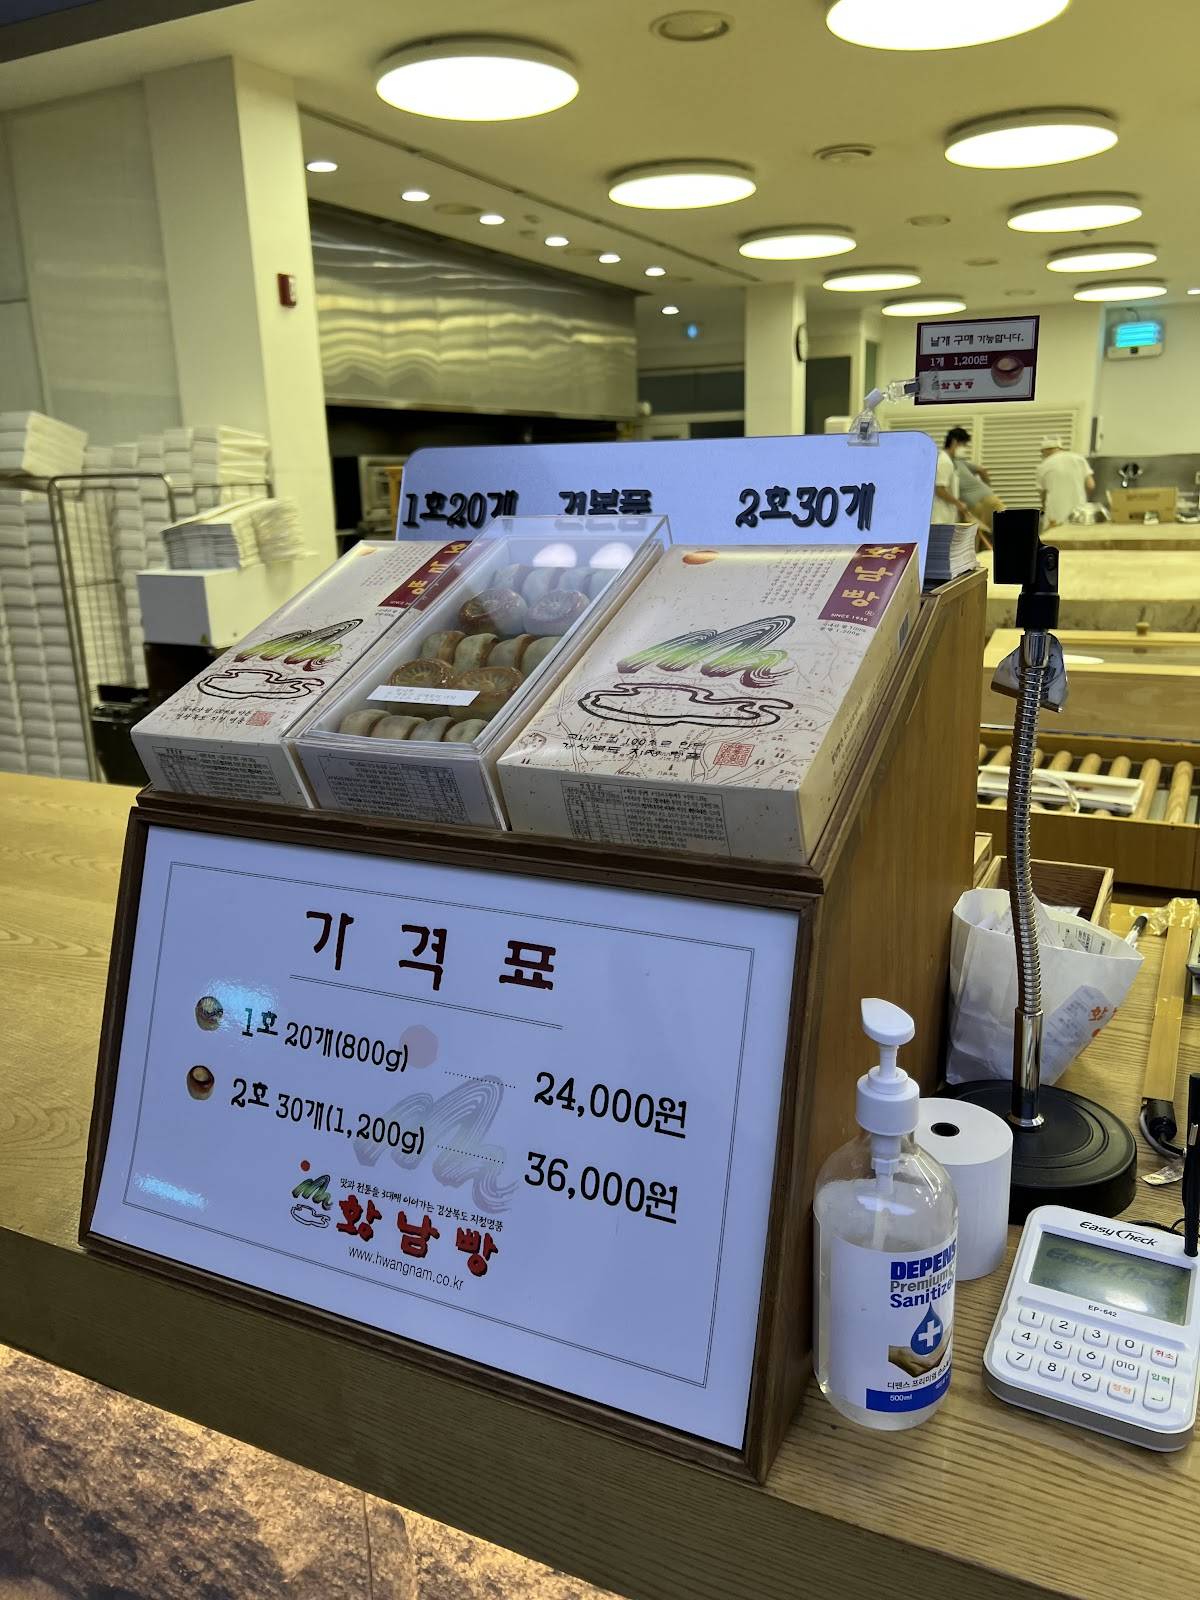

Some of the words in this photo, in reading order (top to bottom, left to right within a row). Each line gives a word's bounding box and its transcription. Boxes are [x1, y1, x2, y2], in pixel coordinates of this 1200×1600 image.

[954, 334, 974, 345] 구매
[977, 333, 1024, 344] 가능합니다.
[930, 356, 945, 367] 1개
[954, 355, 988, 367] 1,200원
[402, 490, 519, 529] 1호20개
[735, 482, 876, 531] 2호30개
[242, 1008, 278, 1037] 1호
[285, 1022, 409, 1072] 20개(800g)
[534, 1071, 687, 1138] 24,000원
[231, 1078, 270, 1108] 2호
[276, 1094, 424, 1154] 30개(1,200g)
[524, 1152, 678, 1224] 36,000원
[340, 1178, 355, 1190] 맛과
[356, 1182, 380, 1198] 전통을
[403, 1196, 435, 1213] 이어가는
[437, 1204, 469, 1222] 경상북도
[348, 1246, 464, 1290] www.hwangnam.co.kr
[891, 1270, 948, 1292] Premium
[891, 1279, 953, 1308] Sanitize
[1030, 1311, 1036, 1320] 1
[1088, 1304, 1117, 1318] EP-642
[1058, 1320, 1068, 1330] 2
[1021, 1332, 1031, 1341] 4
[1091, 1330, 1101, 1339] 3
[1053, 1341, 1063, 1350] 5
[1124, 1339, 1135, 1349] 0
[1016, 1352, 1025, 1361] 7
[1086, 1351, 1096, 1360] 6
[1154, 1349, 1174, 1359] 취소
[1047, 1363, 1057, 1372] 8
[1116, 1359, 1135, 1371] 010
[888, 1381, 910, 1389] 디펜스
[912, 1372, 937, 1387] 프리미엄
[1082, 1373, 1092, 1382] 9
[1151, 1372, 1170, 1384] 입력
[890, 1394, 912, 1402] 500ml
